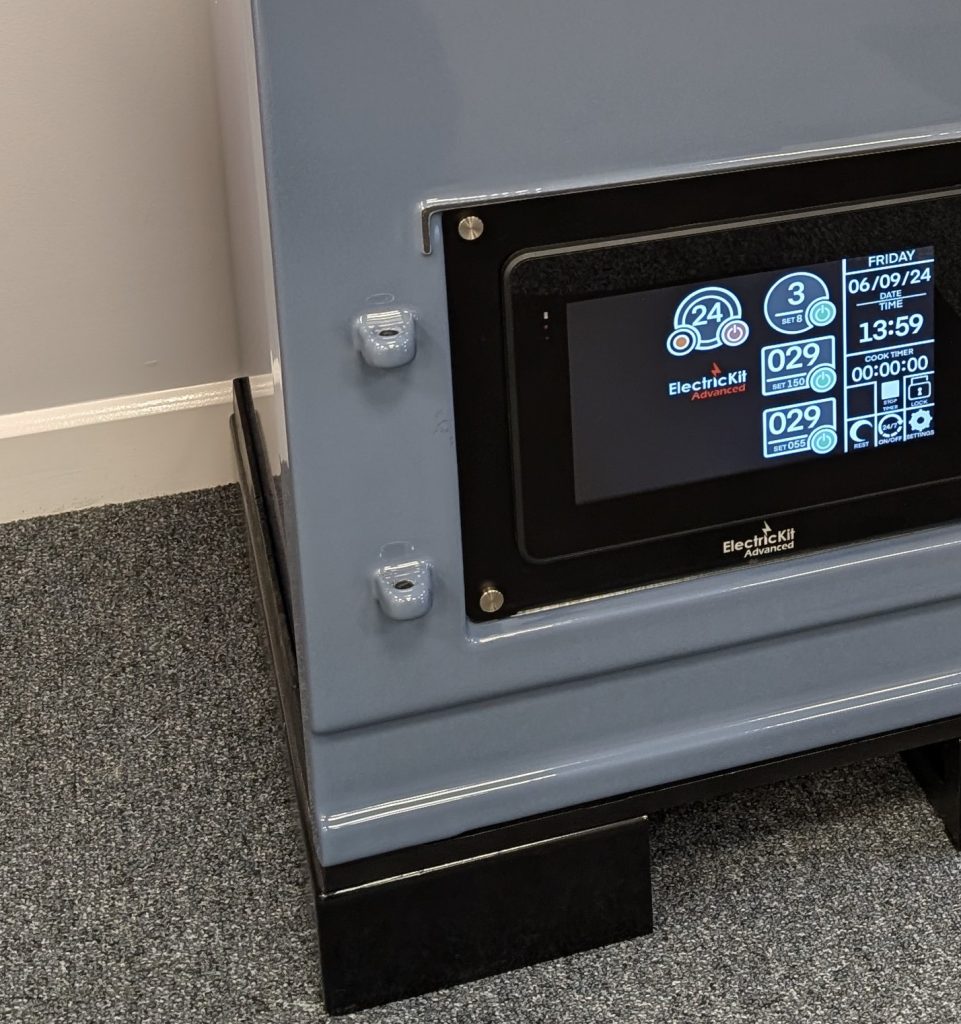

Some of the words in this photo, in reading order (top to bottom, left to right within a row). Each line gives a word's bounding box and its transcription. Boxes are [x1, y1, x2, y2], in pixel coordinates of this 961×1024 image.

[868, 249, 916, 267] FRIDAY
[848, 267, 932, 294] 06/09/24
[787, 281, 805, 306] 3
[880, 289, 902, 299] DATE
[879, 299, 903, 311] TIME
[691, 302, 724, 327] 24
[781, 317, 795, 325] SET
[796, 314, 803, 323] 8
[859, 313, 924, 343] 13:59
[767, 342, 821, 373] 029
[864, 352, 890, 362] COOK
[891, 348, 914, 358] TIMER
[851, 355, 929, 383] 00:00:00
[668, 369, 748, 396] ElectricKit
[772, 382, 786, 390] SET
[787, 377, 805, 388] 150
[691, 384, 746, 401] Advanced
[768, 405, 821, 436] 029
[882, 422, 898, 431] 24/7
[773, 444, 787, 452] SET
[788, 439, 806, 449] 055
[878, 436, 903, 445] ON/OFF
[722, 528, 796, 554] ElectricKit
[743, 541, 795, 559] Advanced
